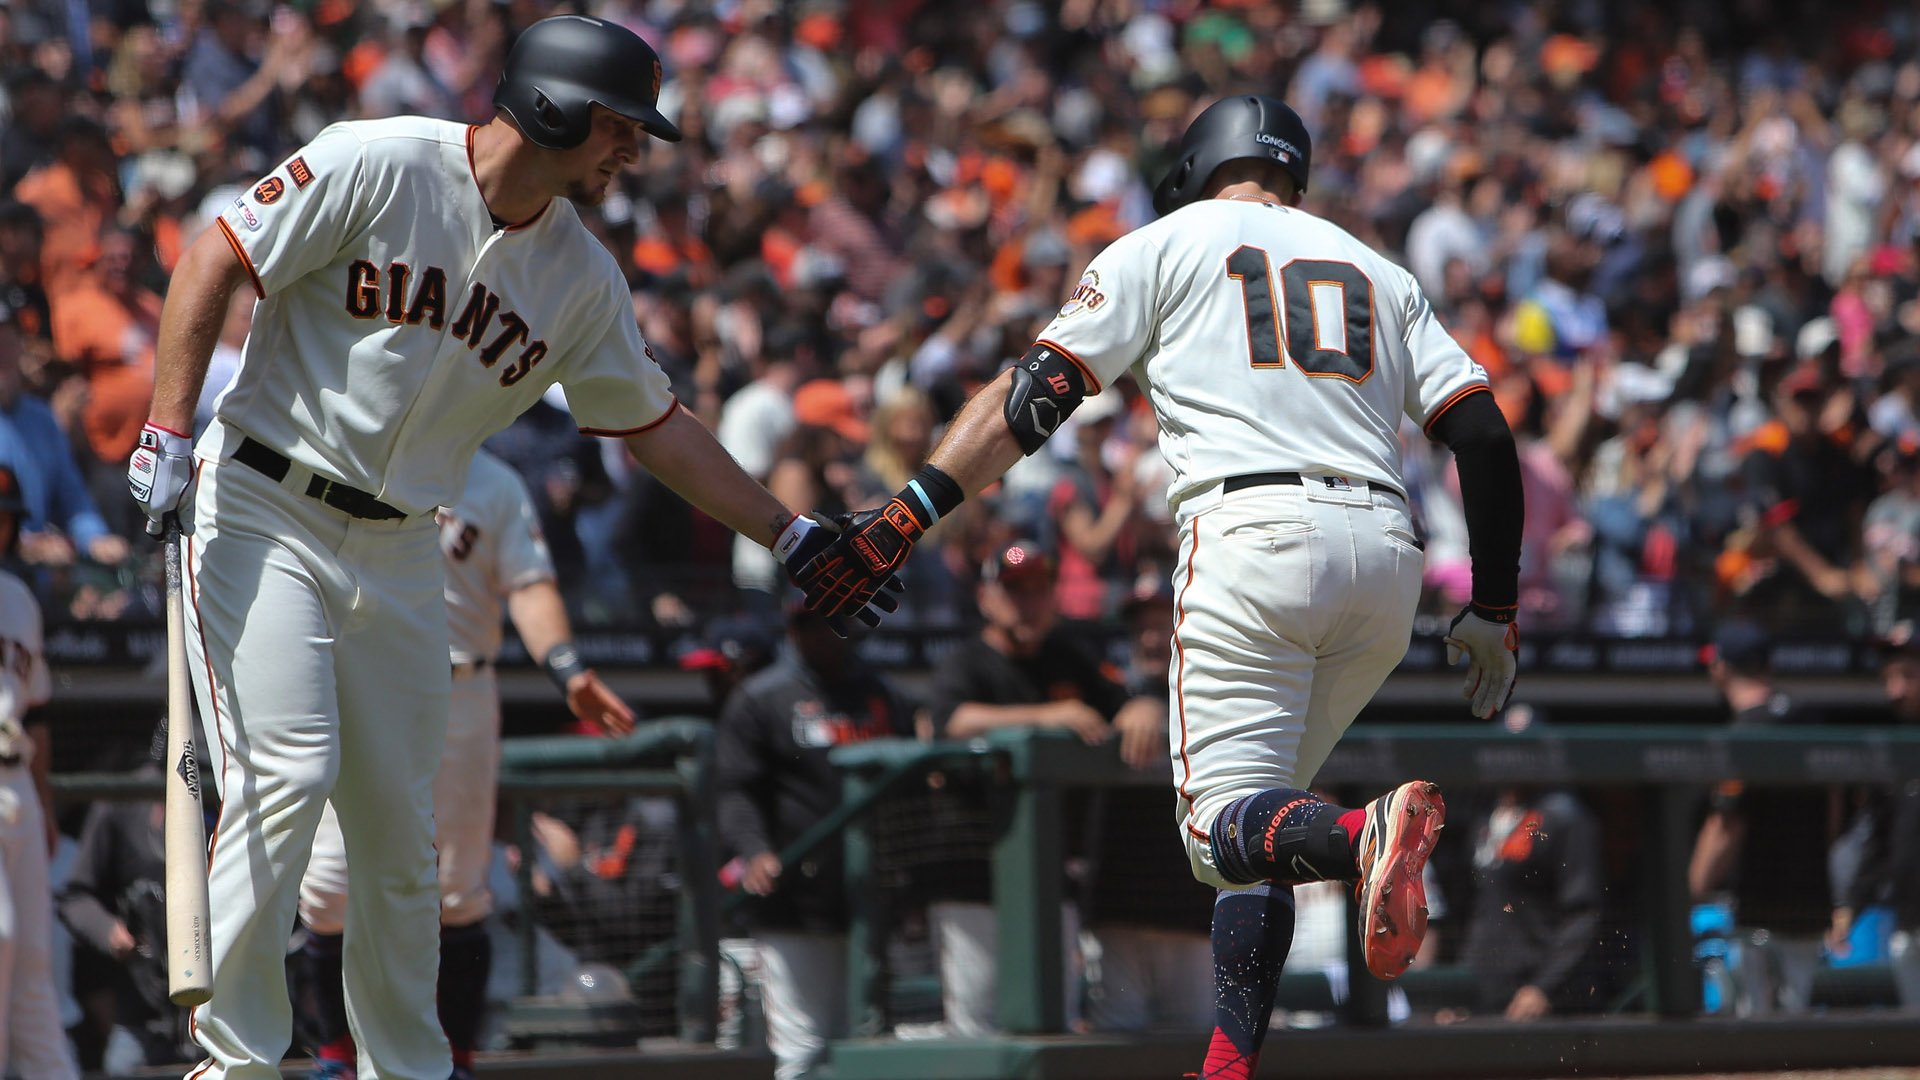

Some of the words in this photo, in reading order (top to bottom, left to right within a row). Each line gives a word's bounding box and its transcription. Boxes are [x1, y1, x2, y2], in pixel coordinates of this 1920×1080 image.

[257, 182, 277, 202] 44
[290, 159, 309, 184] PETER
[345, 259, 549, 388] GIANTS
[1225, 244, 1376, 386] 10
[1046, 372, 1071, 395] 10
[184, 741, 200, 798] HICKORY
